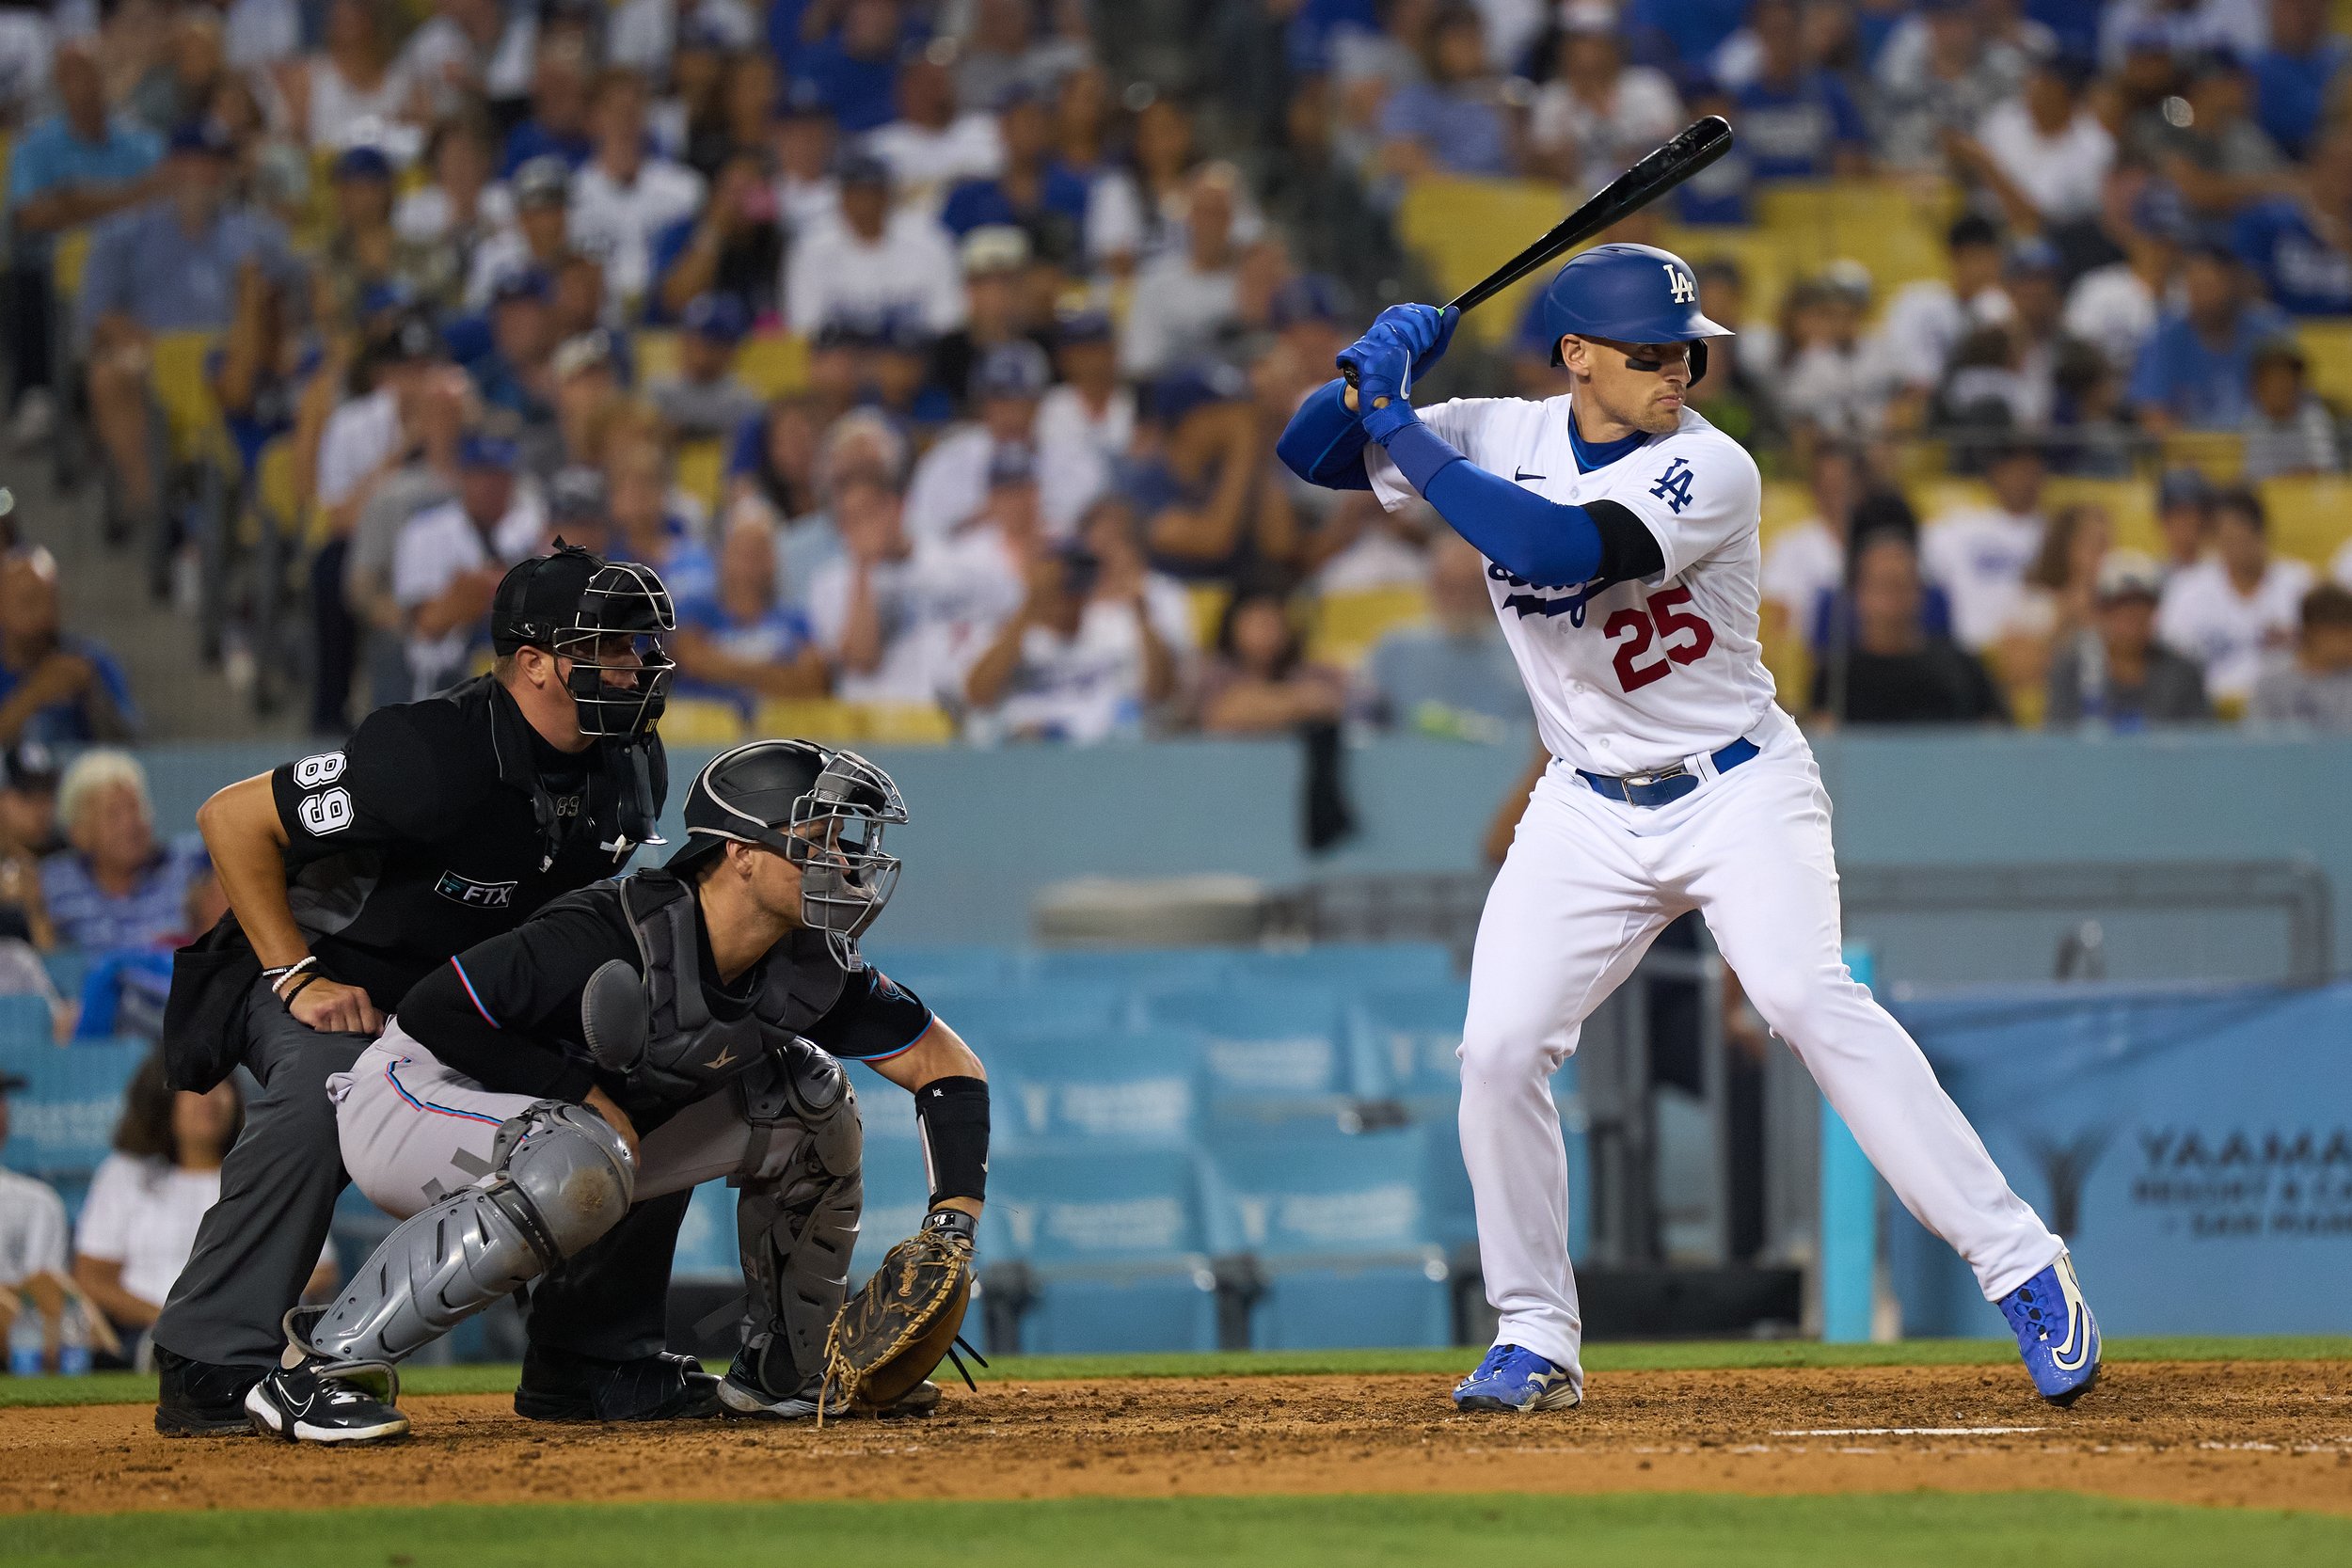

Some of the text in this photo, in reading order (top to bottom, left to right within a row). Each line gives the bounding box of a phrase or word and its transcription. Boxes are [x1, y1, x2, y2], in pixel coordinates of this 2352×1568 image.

[1662, 263, 1695, 304] LA
[1648, 457, 1694, 515] LA
[1602, 585, 1715, 694] 25
[294, 750, 355, 837] 89
[556, 796, 580, 817] 89
[463, 885, 513, 905] FTX
